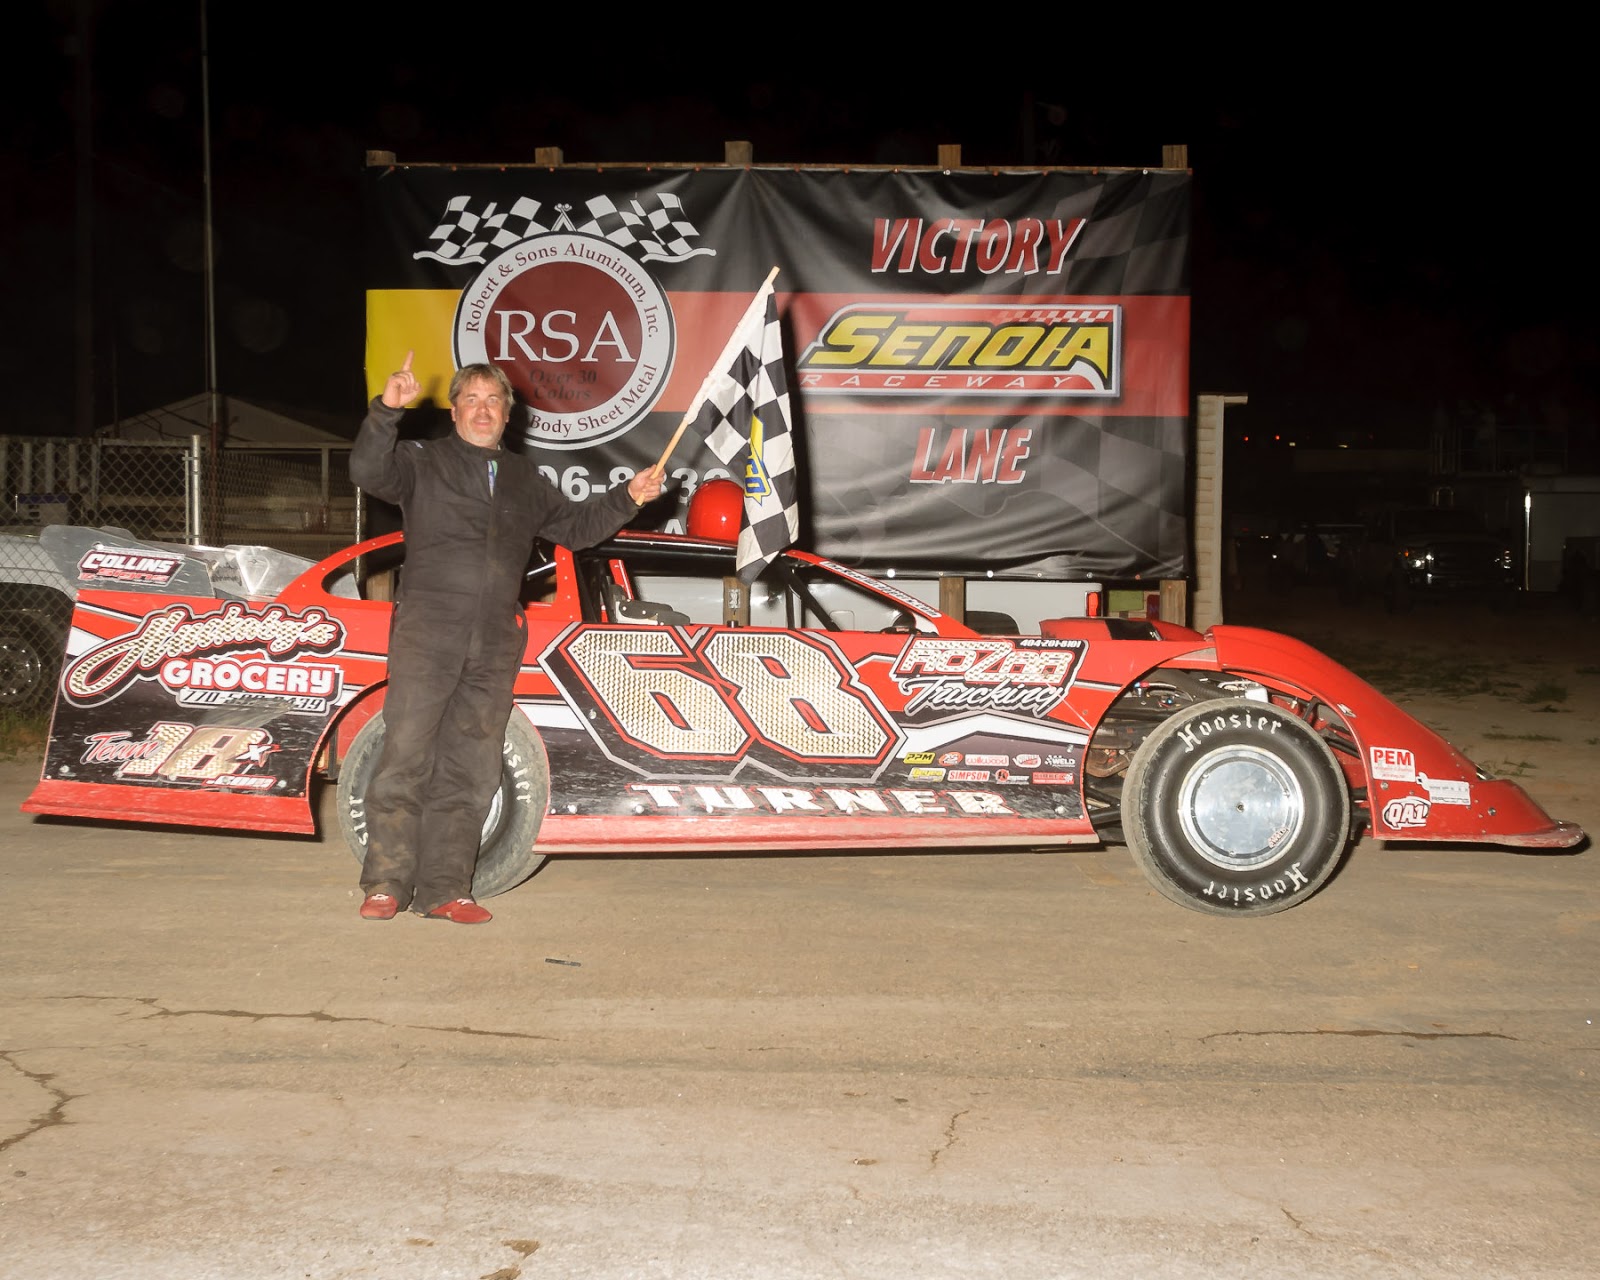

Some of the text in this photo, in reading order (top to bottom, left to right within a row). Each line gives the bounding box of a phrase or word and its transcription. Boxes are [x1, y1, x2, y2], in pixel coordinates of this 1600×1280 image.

[871, 218, 1087, 275] VICTORY
[465, 242, 659, 338] Robert & Sons Aluminum, Inc.
[493, 309, 636, 364] RSA
[806, 313, 1110, 380] SENOIA
[530, 369, 597, 384] Over 30
[534, 386, 592, 400] Colors
[801, 374, 1073, 389] RACEWAY
[530, 364, 657, 437] Body Sheet Metal
[909, 428, 1032, 485] LANE
[81, 553, 175, 573] COLLINS
[162, 659, 334, 694] GROCERY
[567, 631, 889, 757] 68
[902, 676, 1065, 712] Trucking
[87, 732, 160, 762] Team
[1177, 710, 1282, 753] Hoosier
[503, 741, 532, 805] osier
[906, 753, 933, 761] PPM
[1373, 749, 1412, 766] PEM
[950, 771, 989, 780] SIMPSON
[630, 784, 1015, 815] TURNER
[1388, 802, 1425, 827] QA1
[1203, 862, 1309, 906] Hoosier
